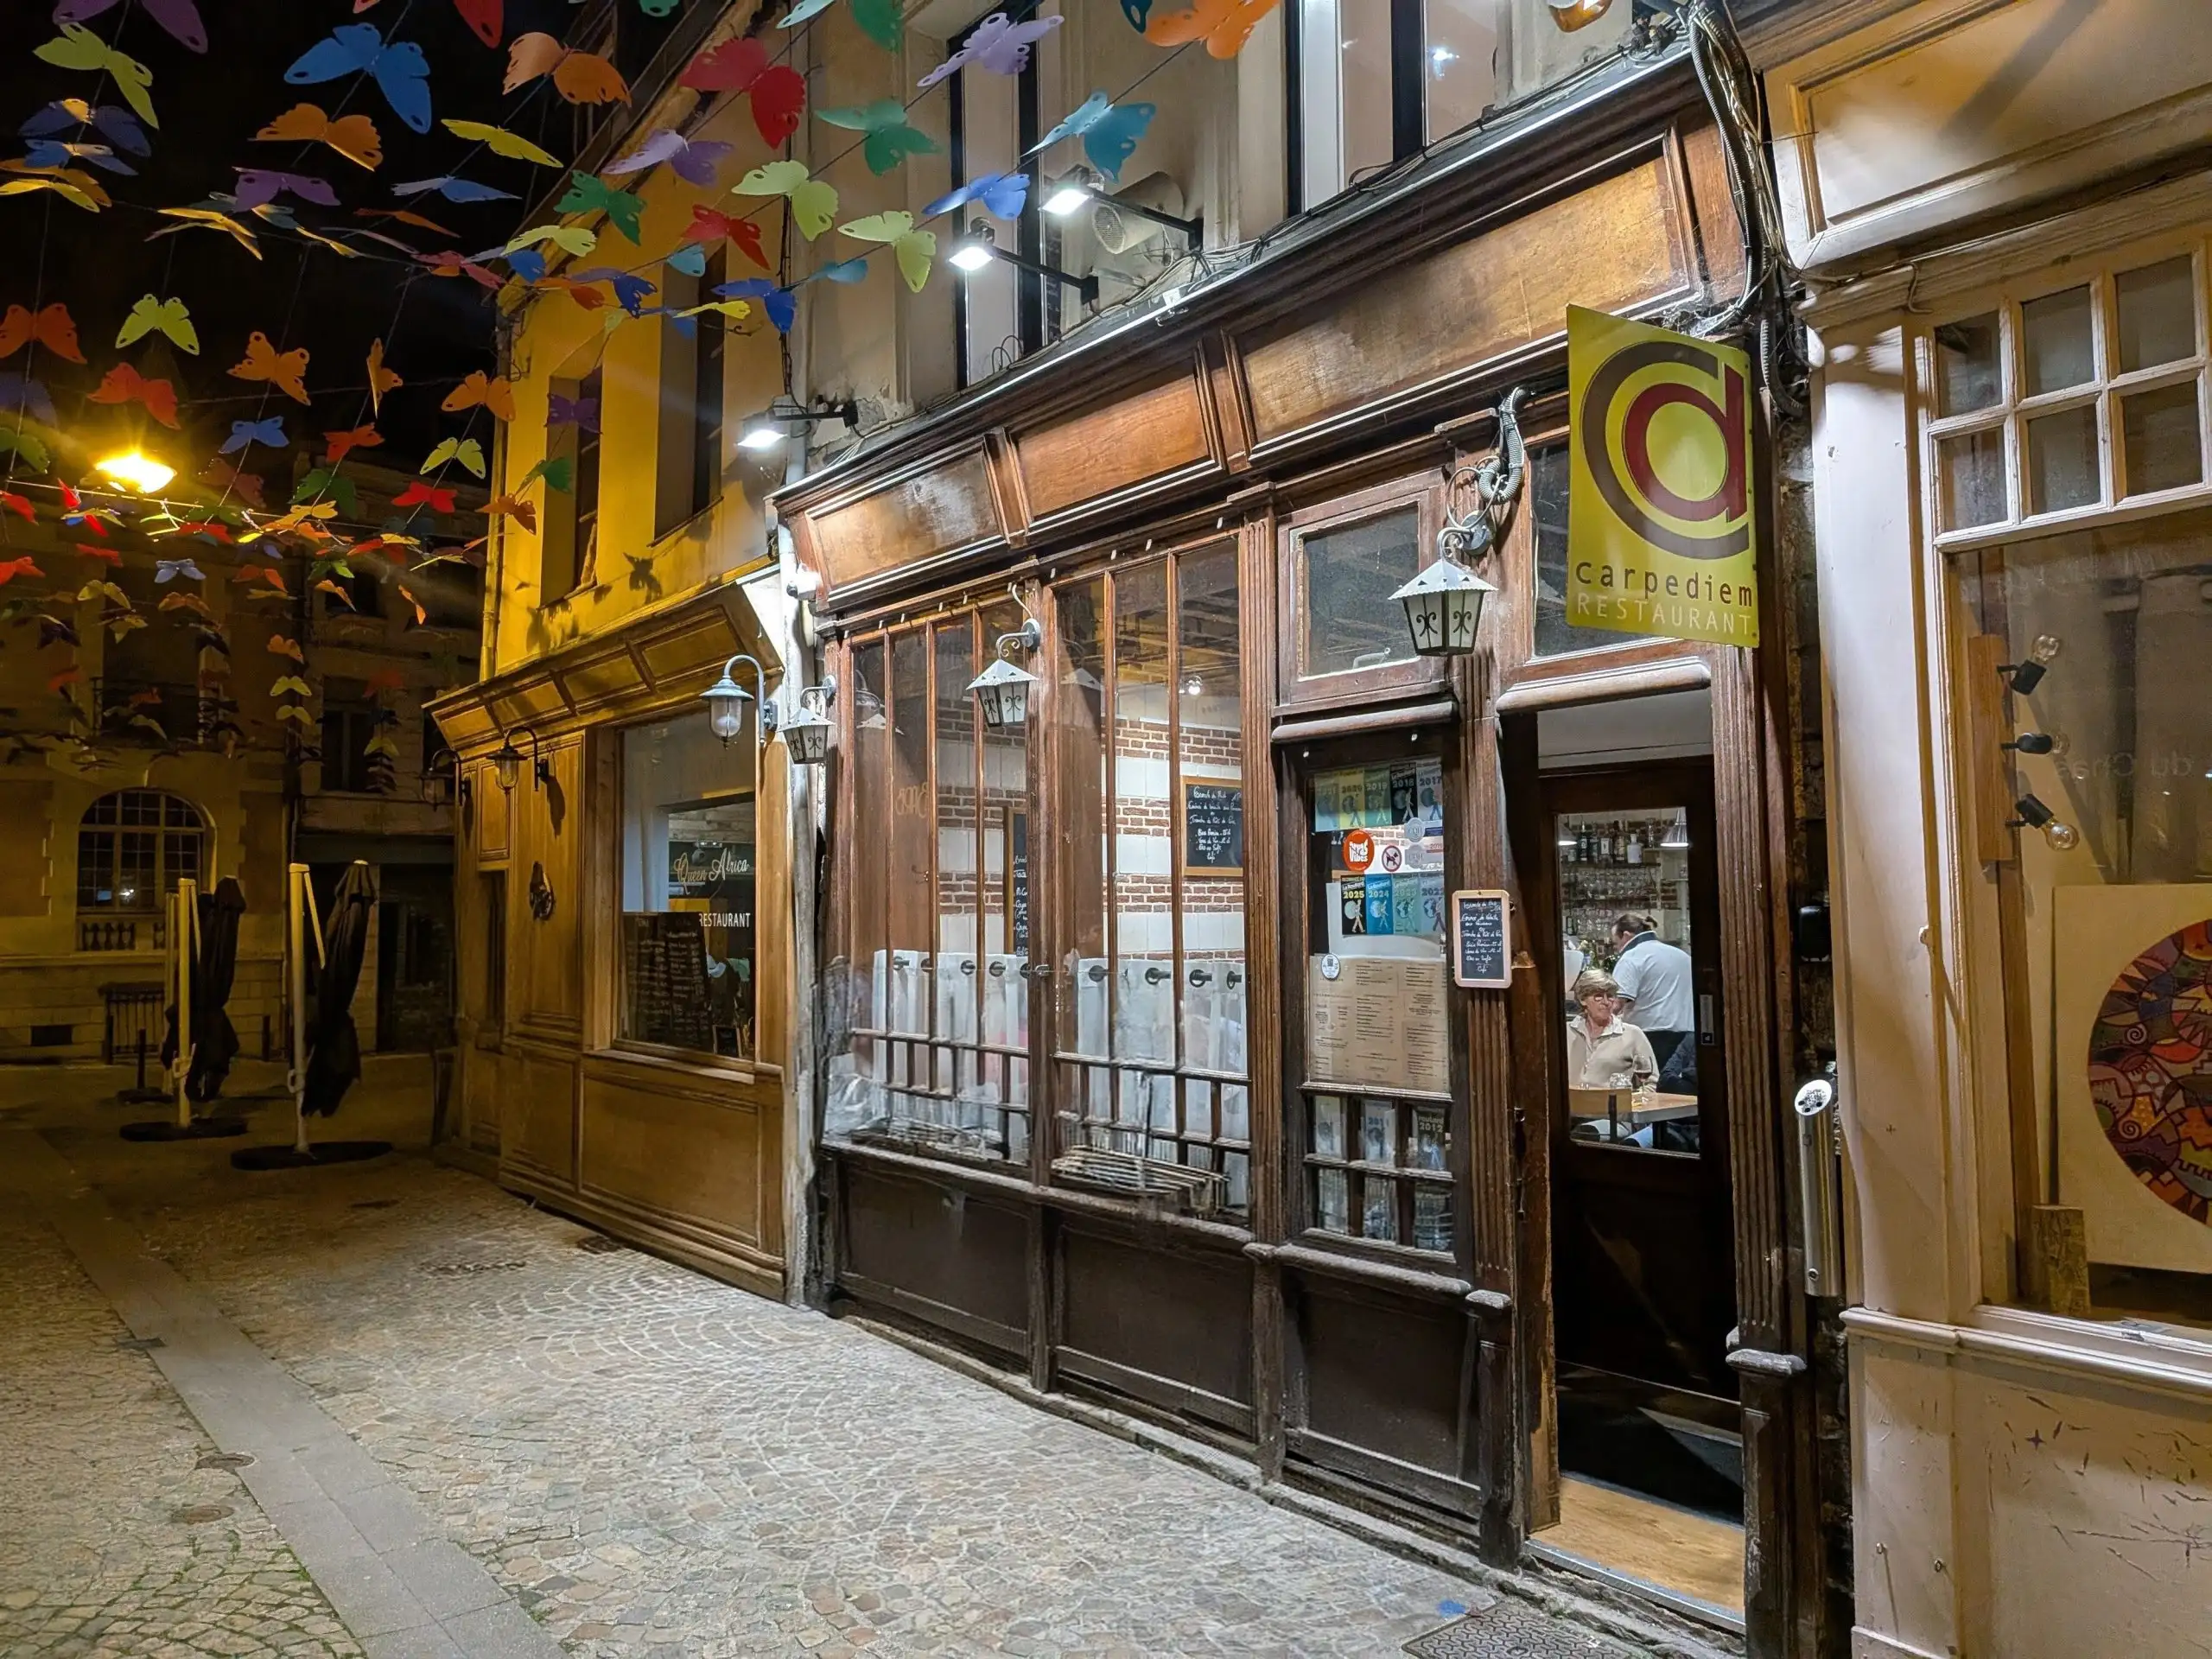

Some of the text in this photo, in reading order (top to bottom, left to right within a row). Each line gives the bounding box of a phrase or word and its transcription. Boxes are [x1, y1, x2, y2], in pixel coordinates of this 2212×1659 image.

[1576, 561, 1752, 607] carpediem
[1577, 592, 1752, 635] RESTAURANT
[1366, 781, 1389, 791] 2019
[1392, 779, 1415, 788] 2018
[1419, 776, 1442, 786] 2017
[1341, 784, 1363, 793] 2020
[674, 852, 709, 895] Queen
[1343, 890, 1365, 899] 2025
[1368, 889, 1390, 899] 2024
[698, 912, 751, 928] RESTAURANT
[1419, 1122, 1444, 1133] 2012
